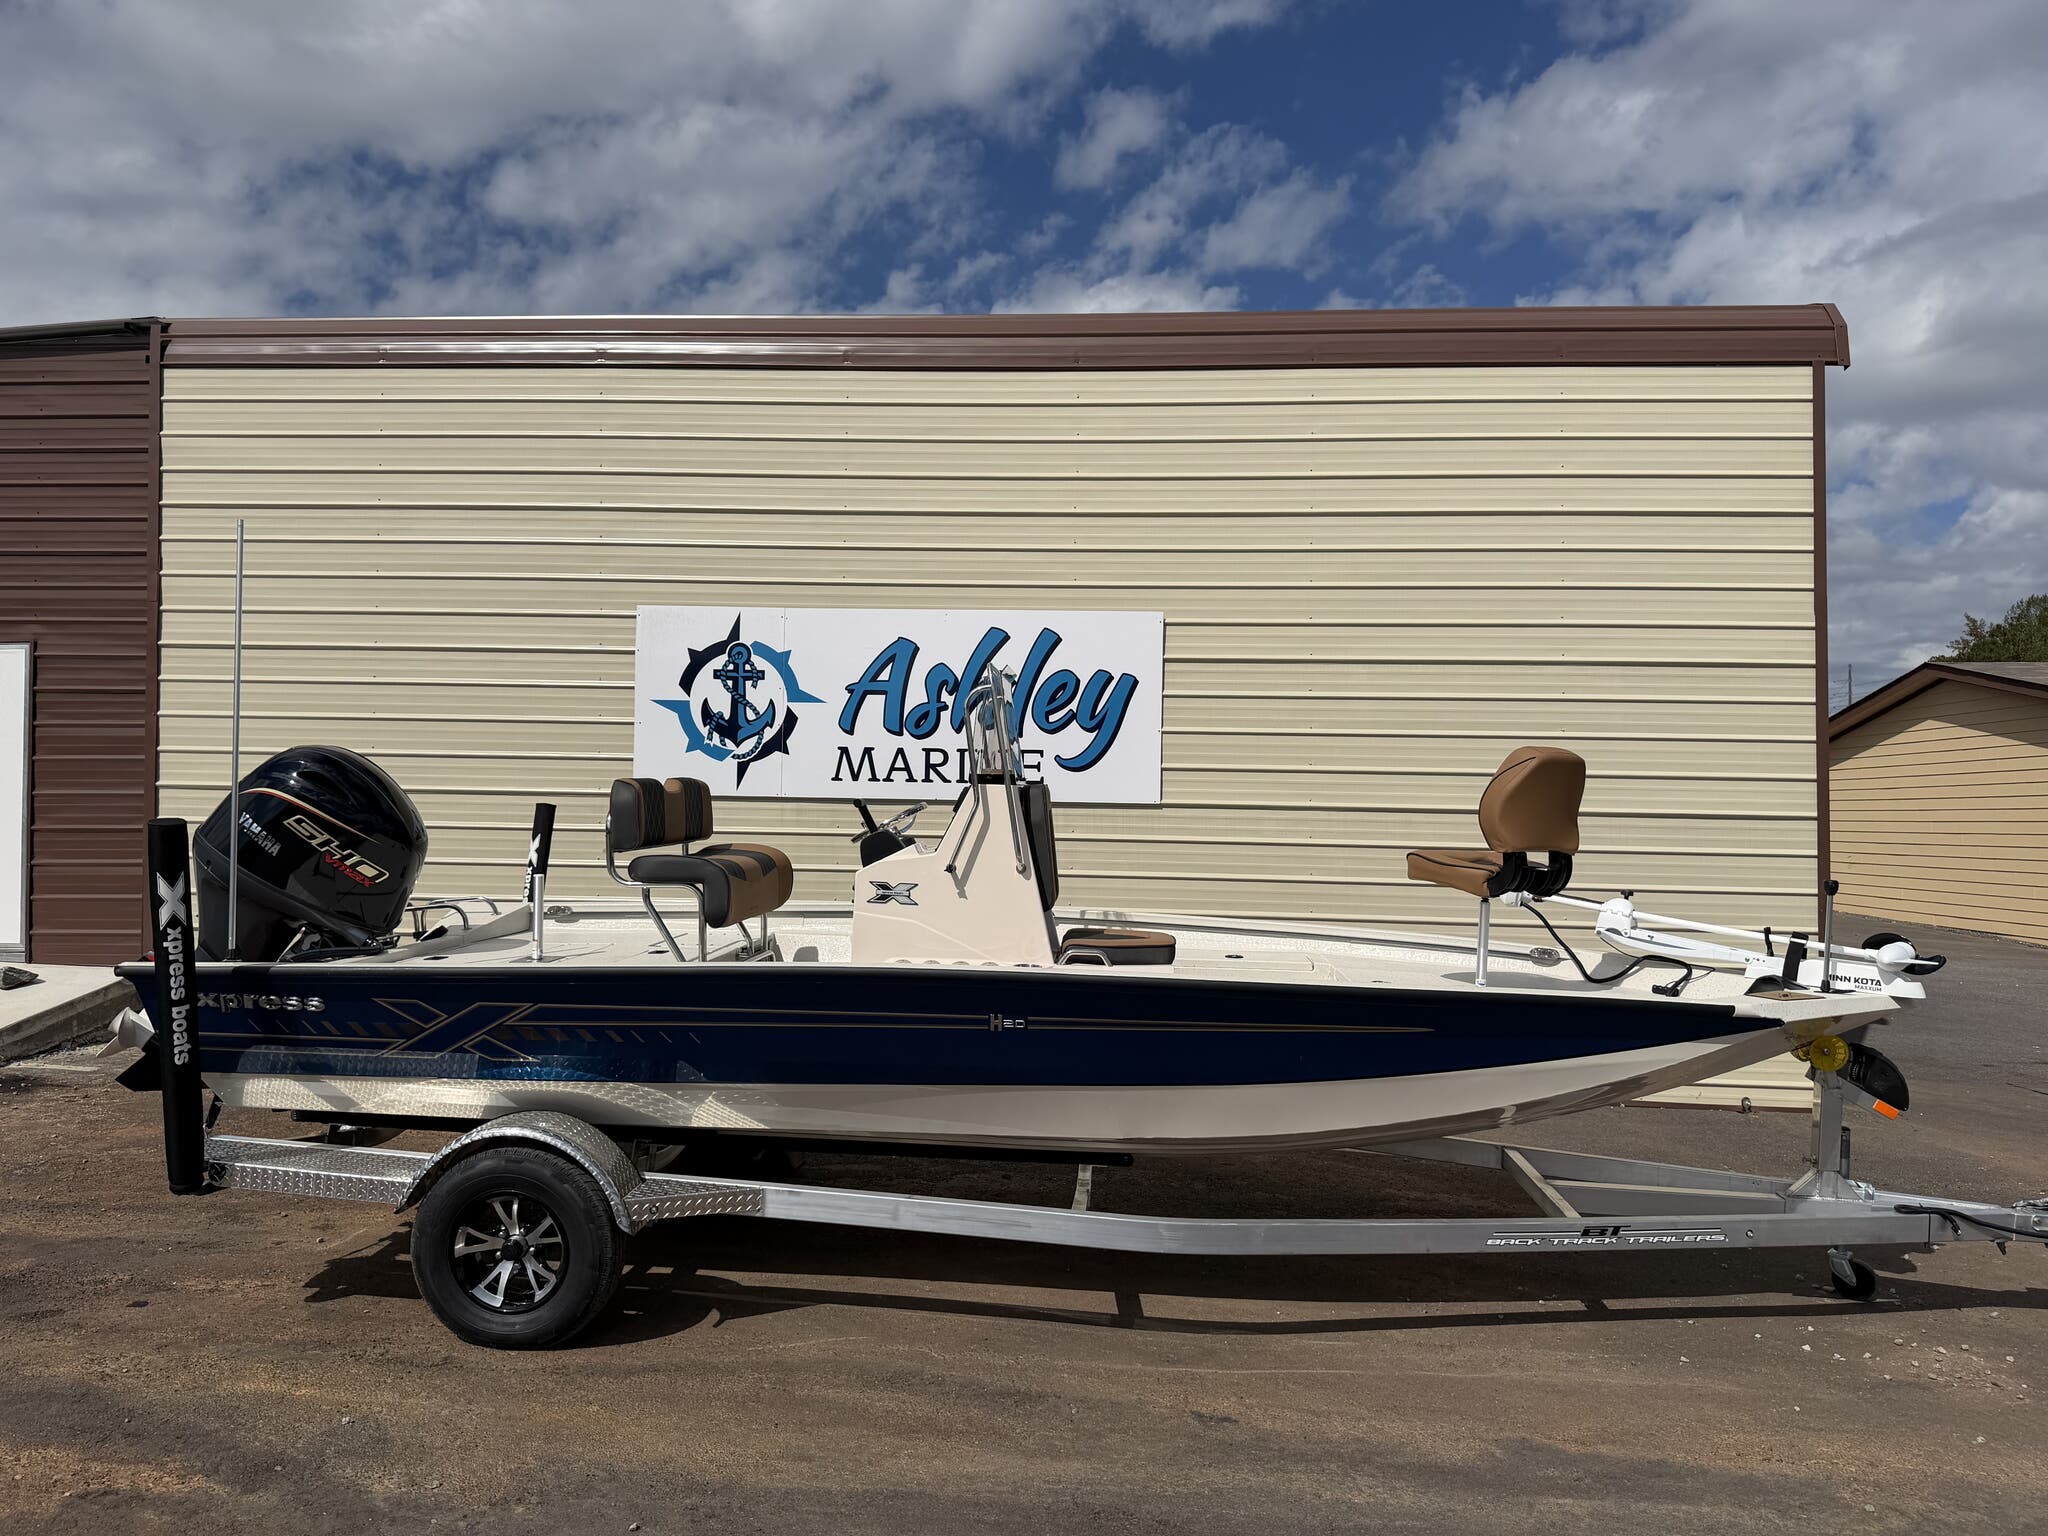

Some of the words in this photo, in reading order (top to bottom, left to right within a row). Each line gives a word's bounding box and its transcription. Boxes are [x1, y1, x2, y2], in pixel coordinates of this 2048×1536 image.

[831, 746, 1044, 784] MARIE
[238, 811, 281, 856] YAMAHA
[283, 815, 390, 883] SHO
[163, 927, 186, 1000] xpress
[1853, 977, 1881, 986] KOTA
[196, 991, 326, 1013] xpress
[1854, 984, 1882, 992] MAXXUM
[171, 1004, 190, 1065] boats
[1486, 1238, 1543, 1246] BACK
[1550, 1236, 1619, 1246] TRACK
